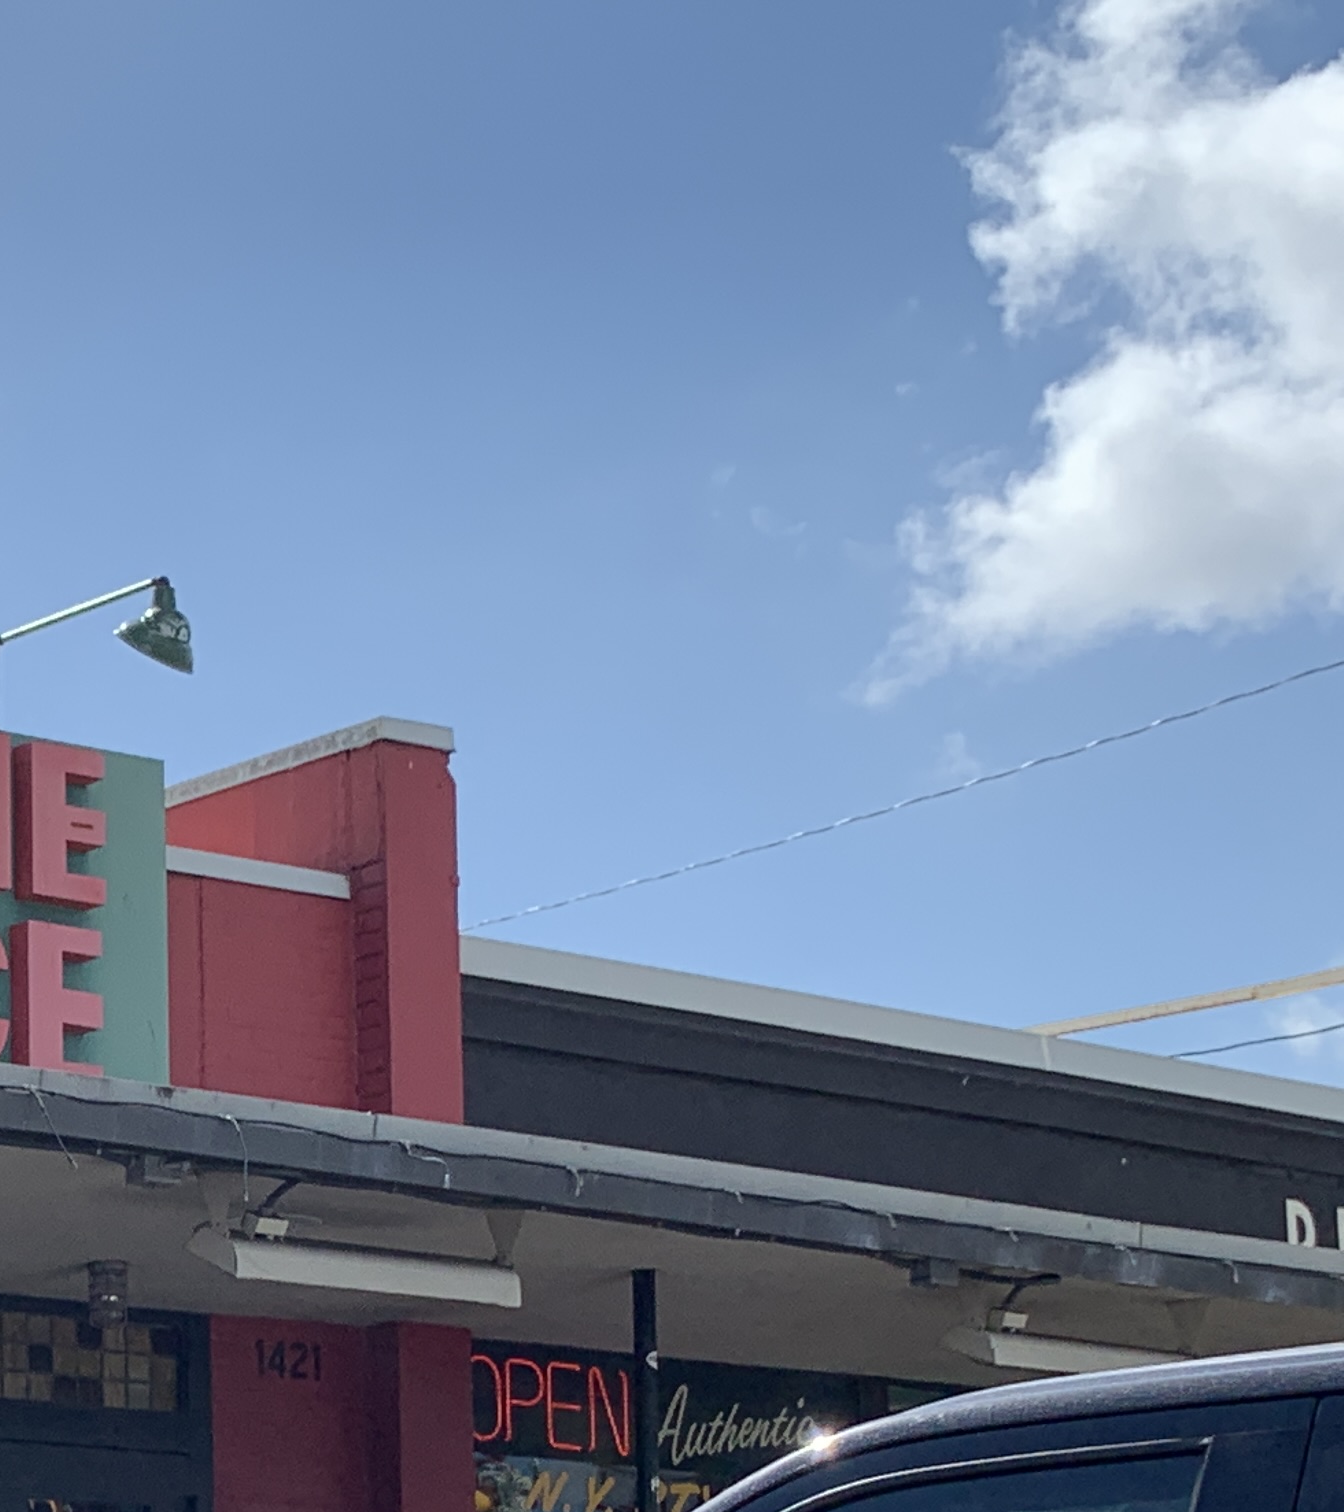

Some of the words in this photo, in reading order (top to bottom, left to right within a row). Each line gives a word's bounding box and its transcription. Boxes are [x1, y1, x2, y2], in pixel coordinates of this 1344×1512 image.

[255, 1339, 321, 1381] 1421
[471, 1354, 630, 1457] OPEN
[657, 1384, 817, 1466] Authentic
